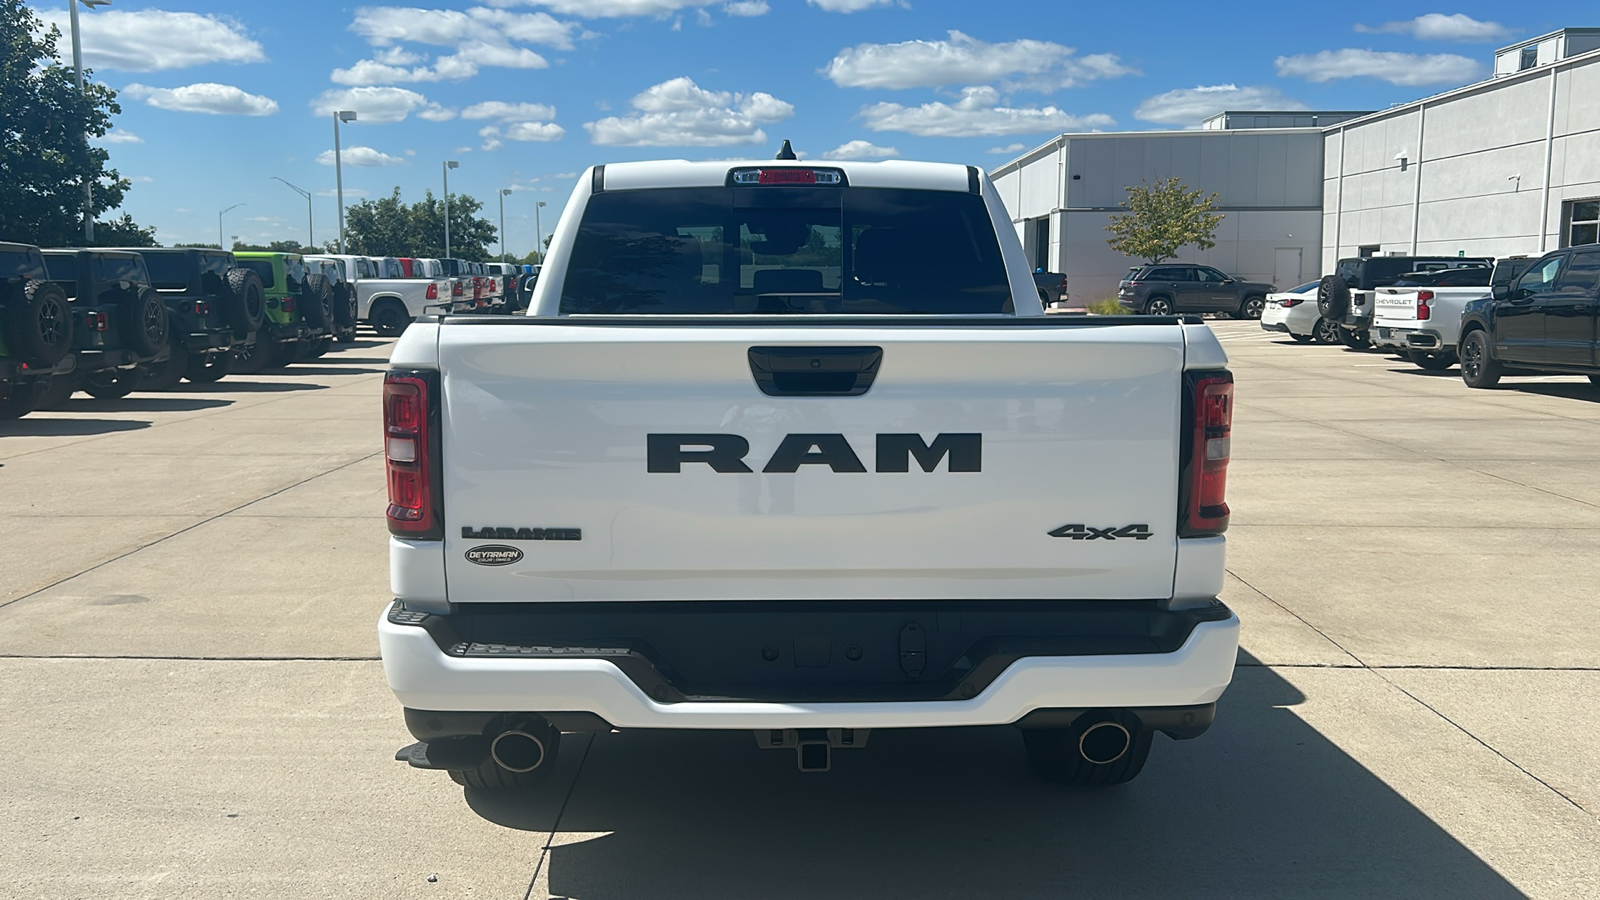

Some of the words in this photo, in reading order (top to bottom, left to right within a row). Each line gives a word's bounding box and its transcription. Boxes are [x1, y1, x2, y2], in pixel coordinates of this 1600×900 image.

[647, 432, 982, 473] RAM
[461, 526, 582, 541] LARAMIE
[1047, 524, 1154, 540] 4x4
[469, 551, 518, 559] DEYARMAN
